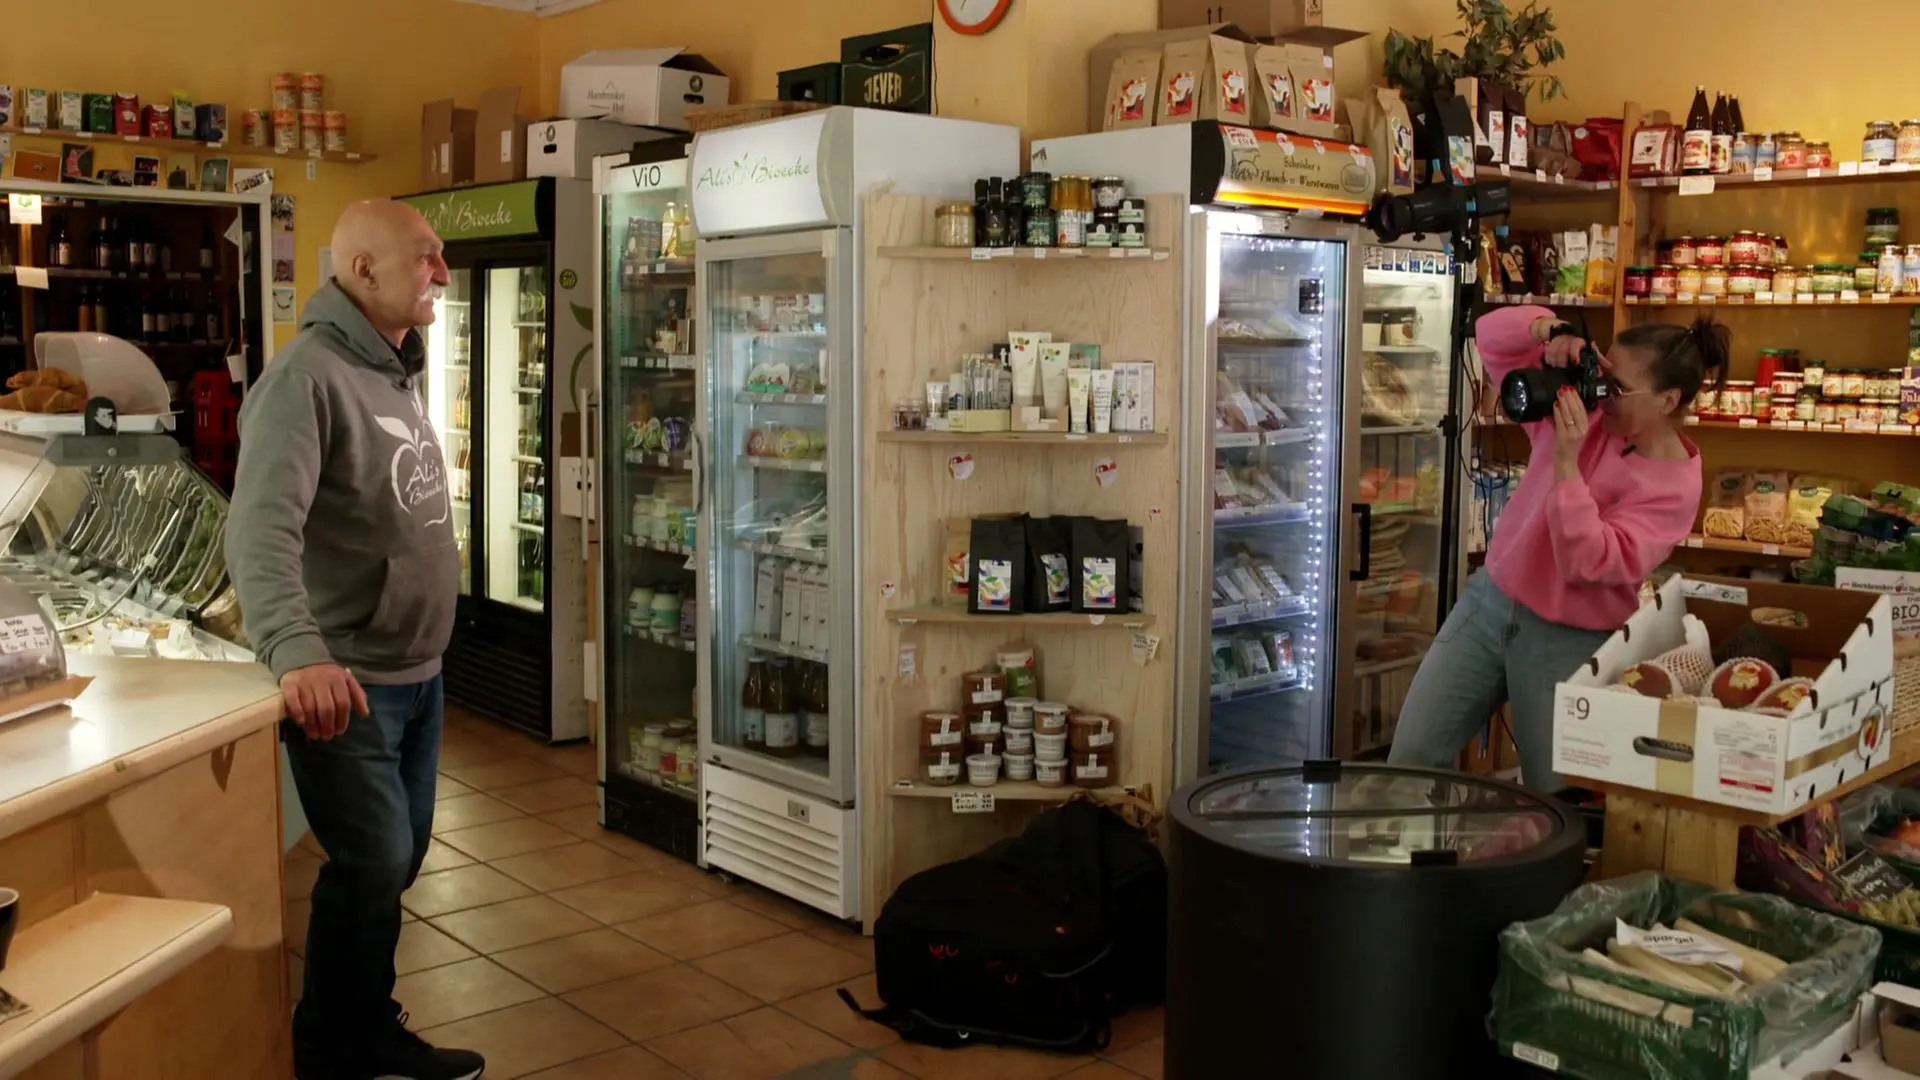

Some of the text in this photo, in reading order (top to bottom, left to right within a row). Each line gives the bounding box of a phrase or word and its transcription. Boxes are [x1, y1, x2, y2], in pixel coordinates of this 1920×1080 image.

[864, 71, 902, 105] JEVER
[632, 165, 662, 188] ViO
[697, 166, 733, 190] Ali's
[405, 459, 440, 492] Ali's
[1576, 697, 1590, 720] 9
